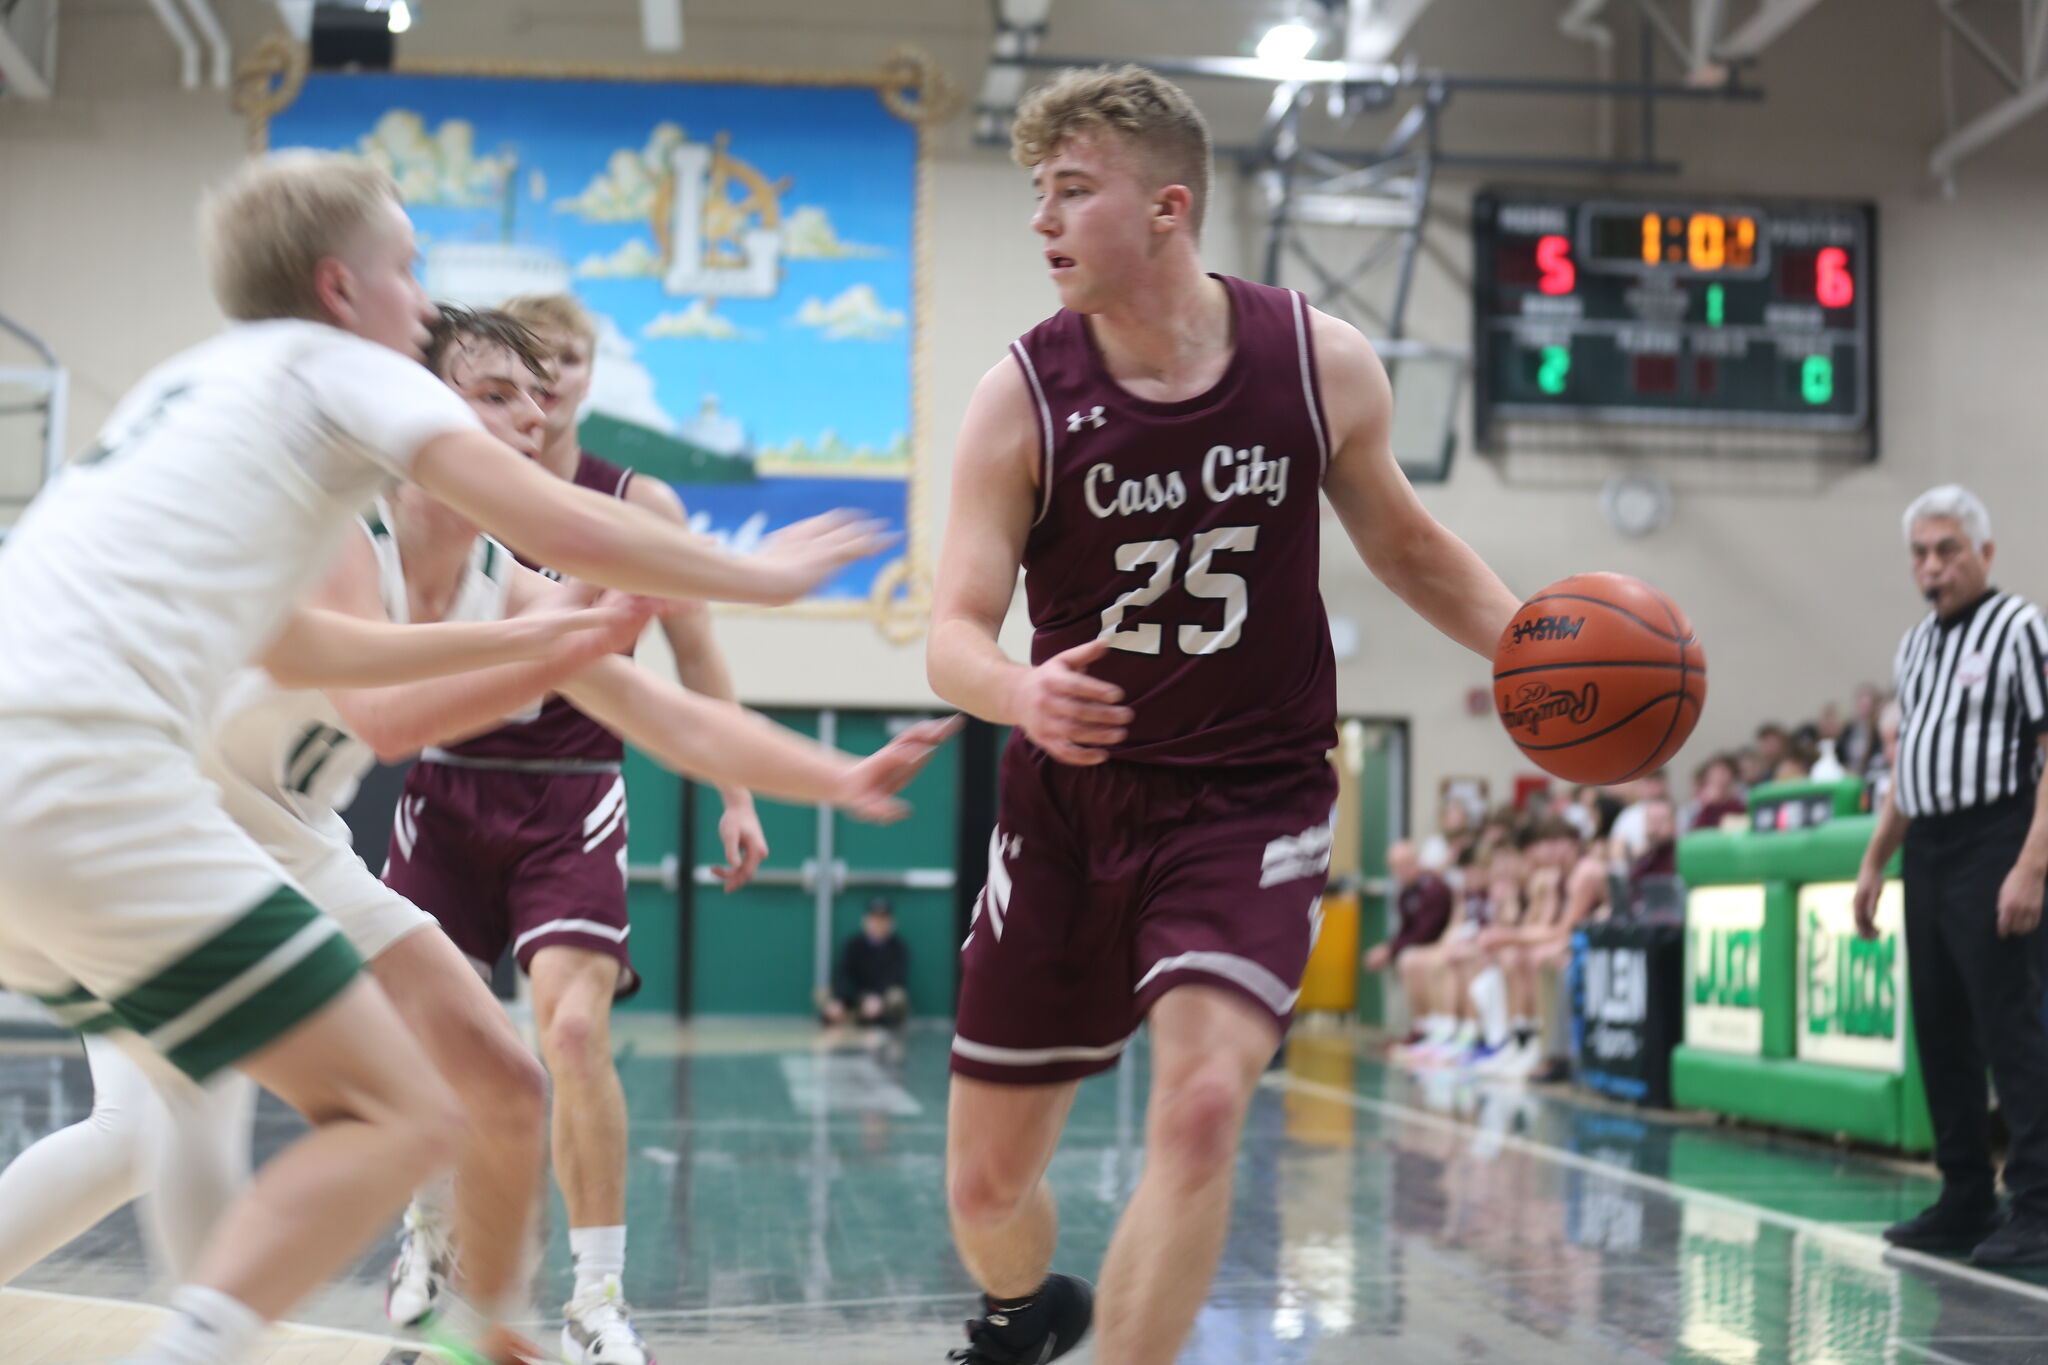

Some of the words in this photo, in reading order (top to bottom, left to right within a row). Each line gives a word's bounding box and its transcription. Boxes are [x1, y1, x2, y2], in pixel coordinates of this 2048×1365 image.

[664, 143, 781, 296] L
[1536, 235, 1575, 295] 5
[1816, 247, 1854, 308] 6
[1706, 283, 1724, 328] 1
[1802, 354, 1833, 403] 0
[1084, 462, 1187, 519] Cass
[1202, 444, 1290, 507] City
[1096, 524, 1260, 655] 25
